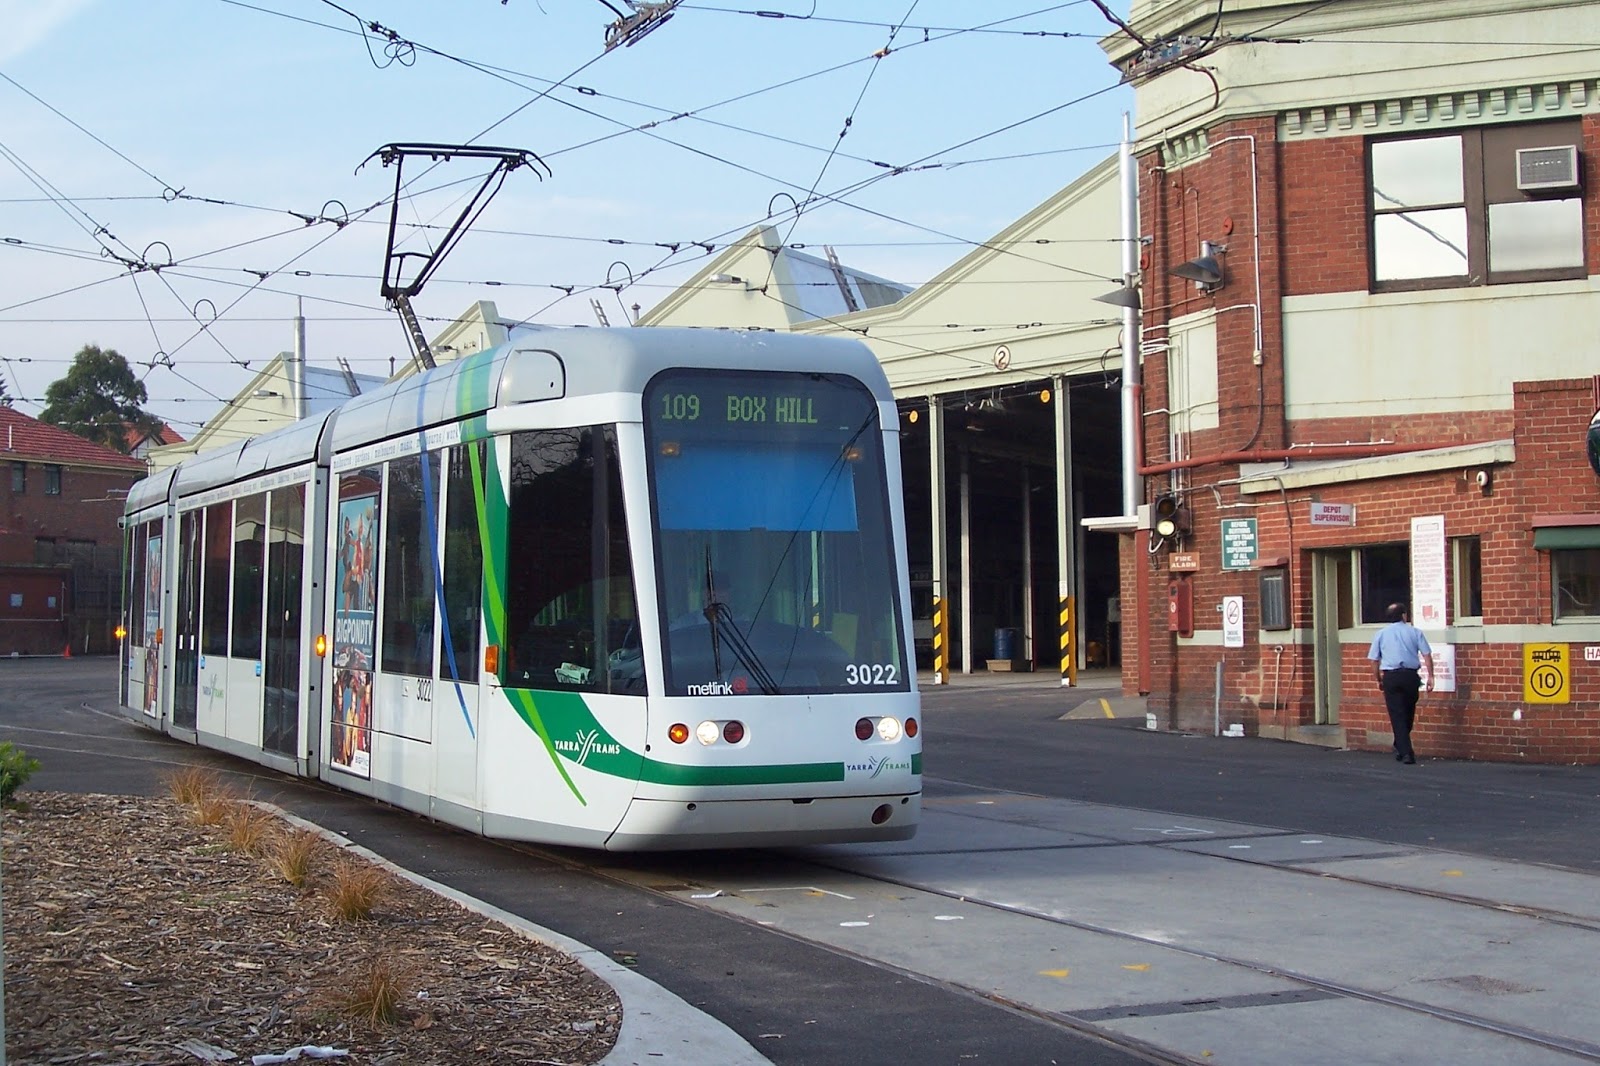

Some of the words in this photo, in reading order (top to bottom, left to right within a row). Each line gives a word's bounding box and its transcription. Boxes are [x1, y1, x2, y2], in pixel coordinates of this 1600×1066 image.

[998, 350, 1006, 367] 2
[662, 394, 700, 420] 109
[727, 396, 766, 422] BOX
[776, 398, 818, 423] HILL
[1314, 514, 1350, 522] SUPERVISOR
[1323, 506, 1341, 514] DEPOT
[846, 664, 898, 685] 3022
[1538, 672, 1556, 689] 10
[416, 678, 431, 702] 3022
[687, 682, 733, 696] metlink
[555, 740, 580, 752] YARRA
[592, 743, 620, 755] TRAMS
[885, 762, 910, 770] TRAMS
